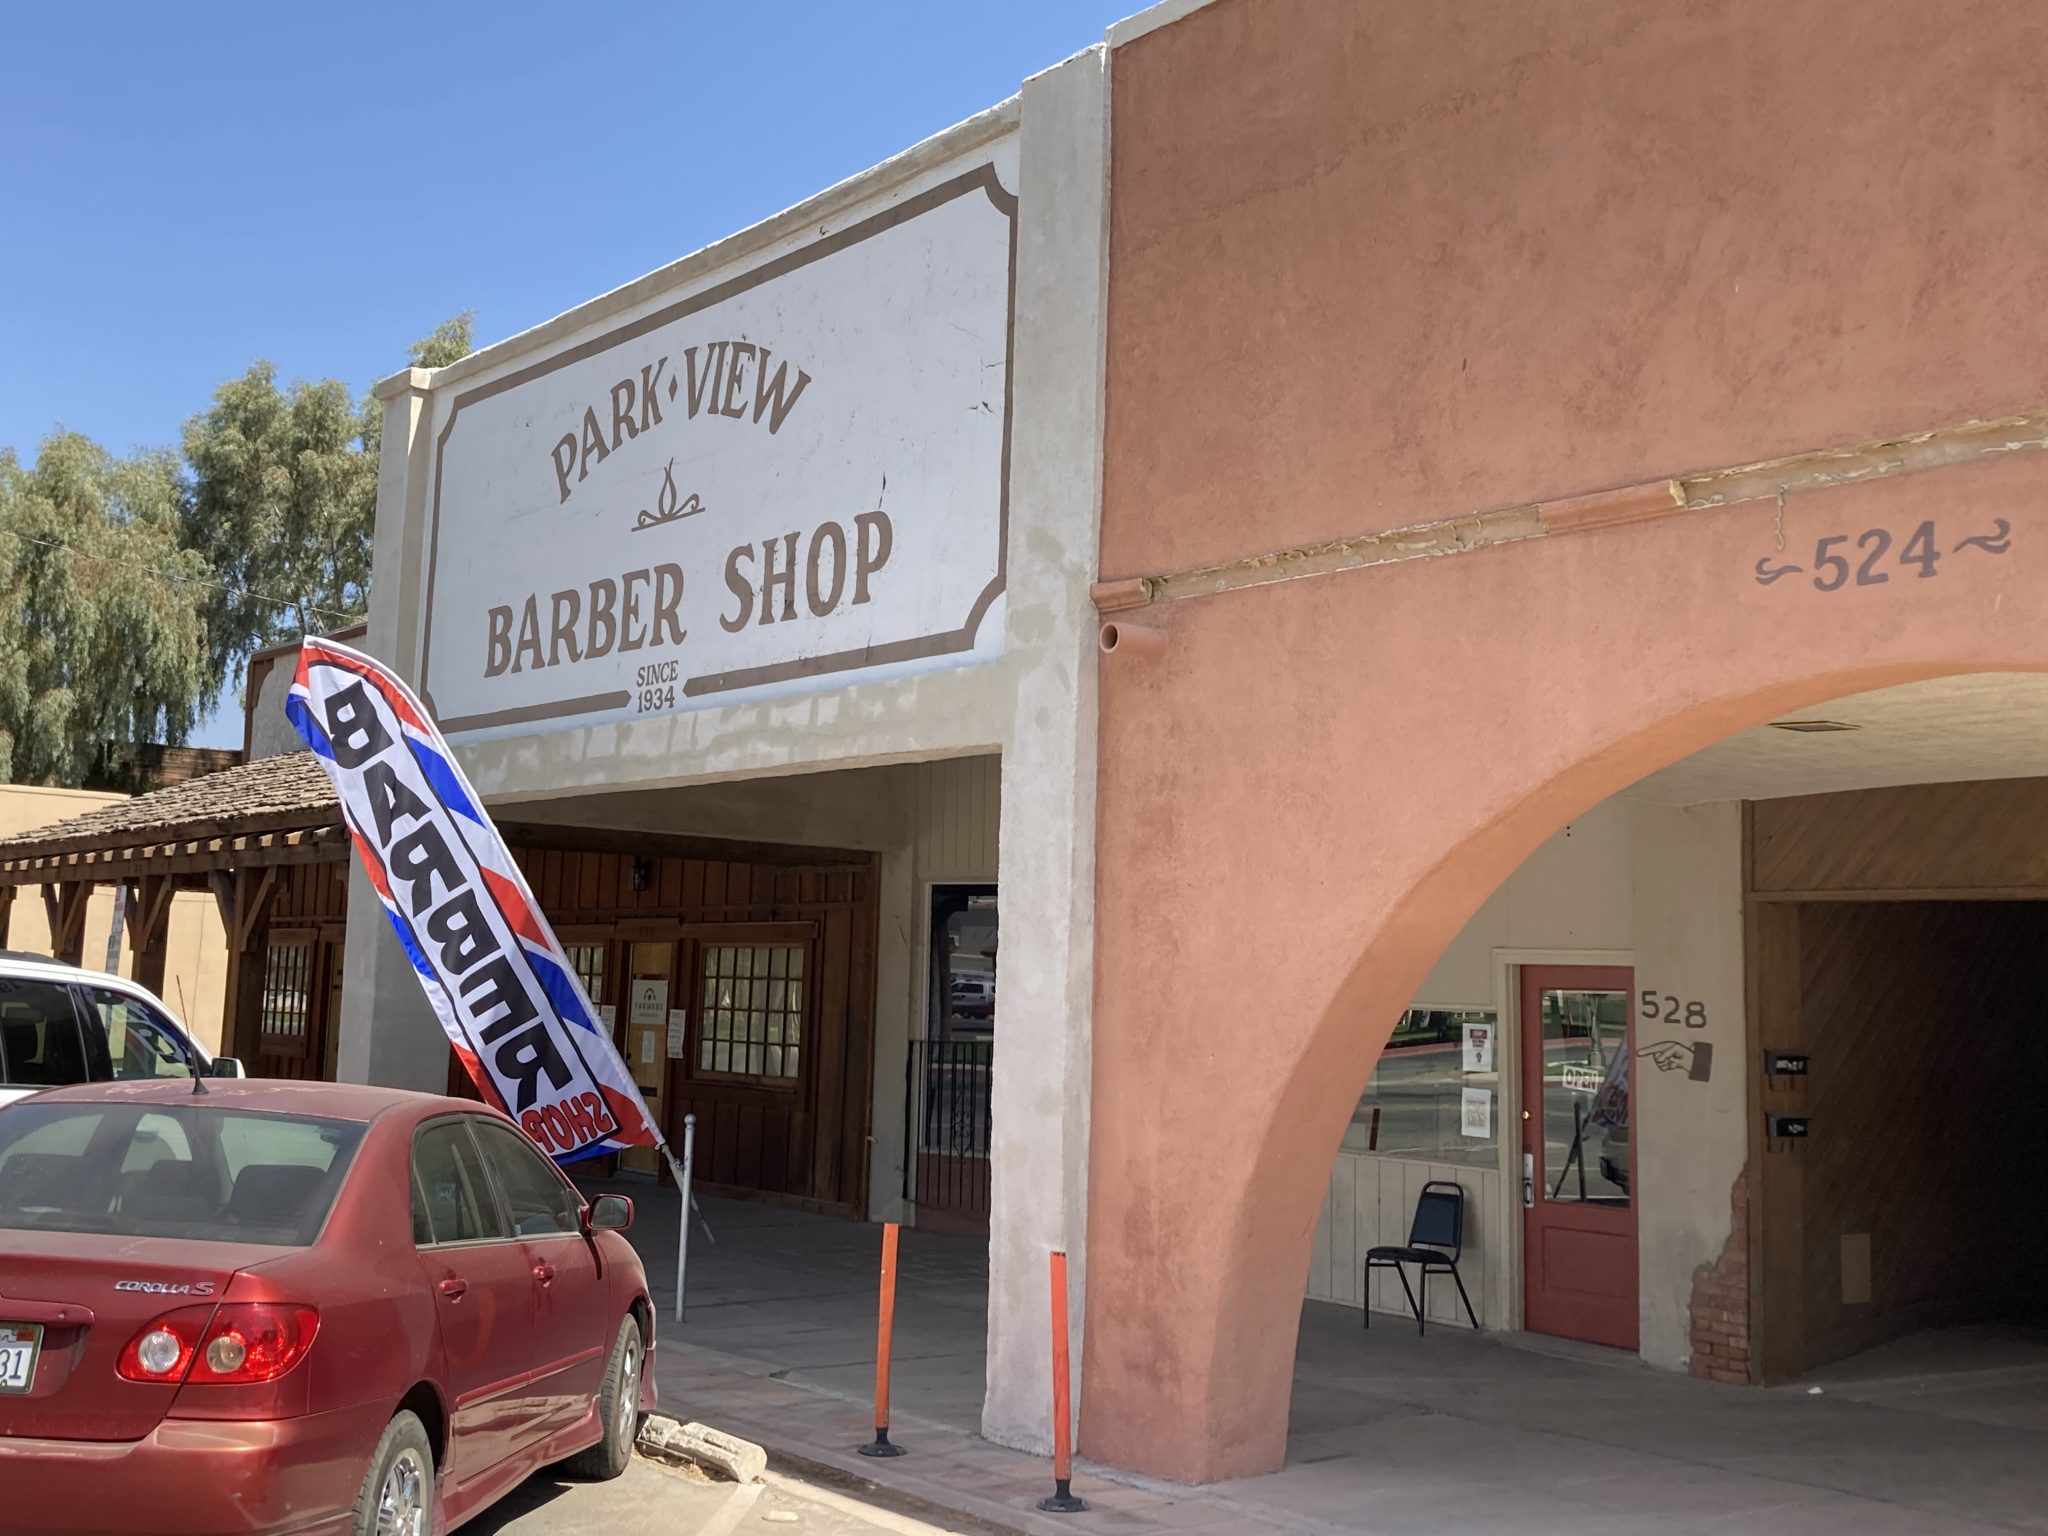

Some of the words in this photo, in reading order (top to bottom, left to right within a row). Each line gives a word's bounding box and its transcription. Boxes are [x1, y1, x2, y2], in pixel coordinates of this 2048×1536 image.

[1813, 520, 1941, 592] 524
[483, 562, 687, 678] BARBER
[719, 510, 893, 634] SHOP
[636, 660, 679, 687] SINCE
[637, 685, 675, 713] 1934
[1641, 990, 1708, 1029] 528
[1565, 1068, 1598, 1090] OPEN
[114, 1280, 190, 1294] COROLLA
[190, 1282, 216, 1296] S
